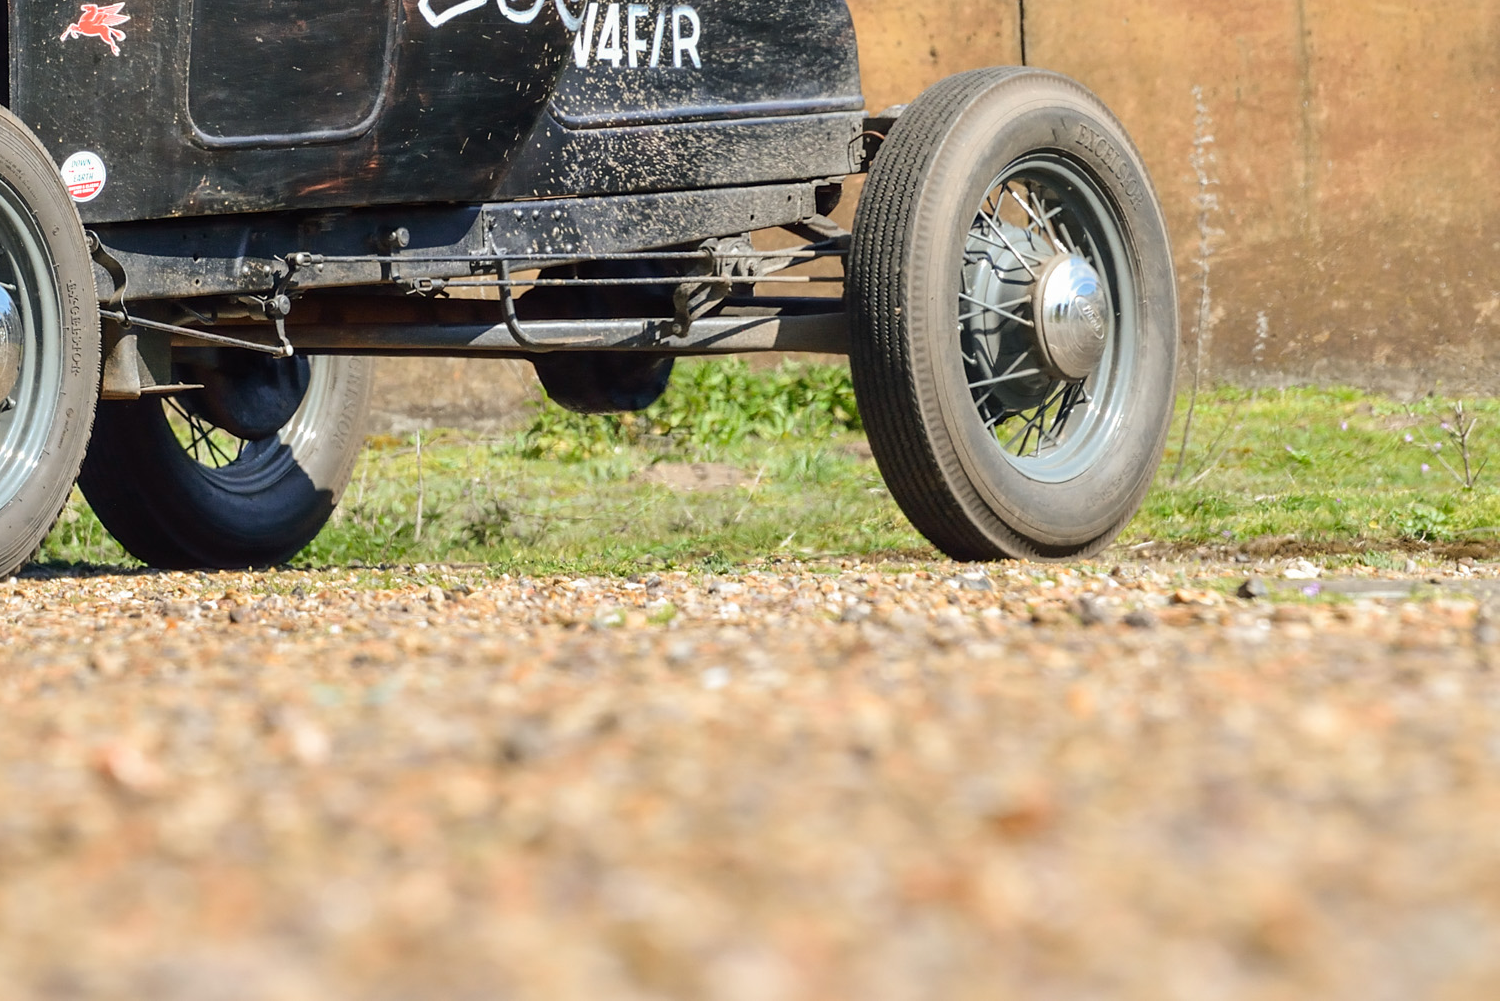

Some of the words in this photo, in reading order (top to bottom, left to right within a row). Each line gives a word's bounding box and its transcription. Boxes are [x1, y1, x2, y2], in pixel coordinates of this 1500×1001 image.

[572, 2, 702, 69] V4F/R
[71, 159, 91, 168] DOWN
[73, 173, 94, 183] EARTH
